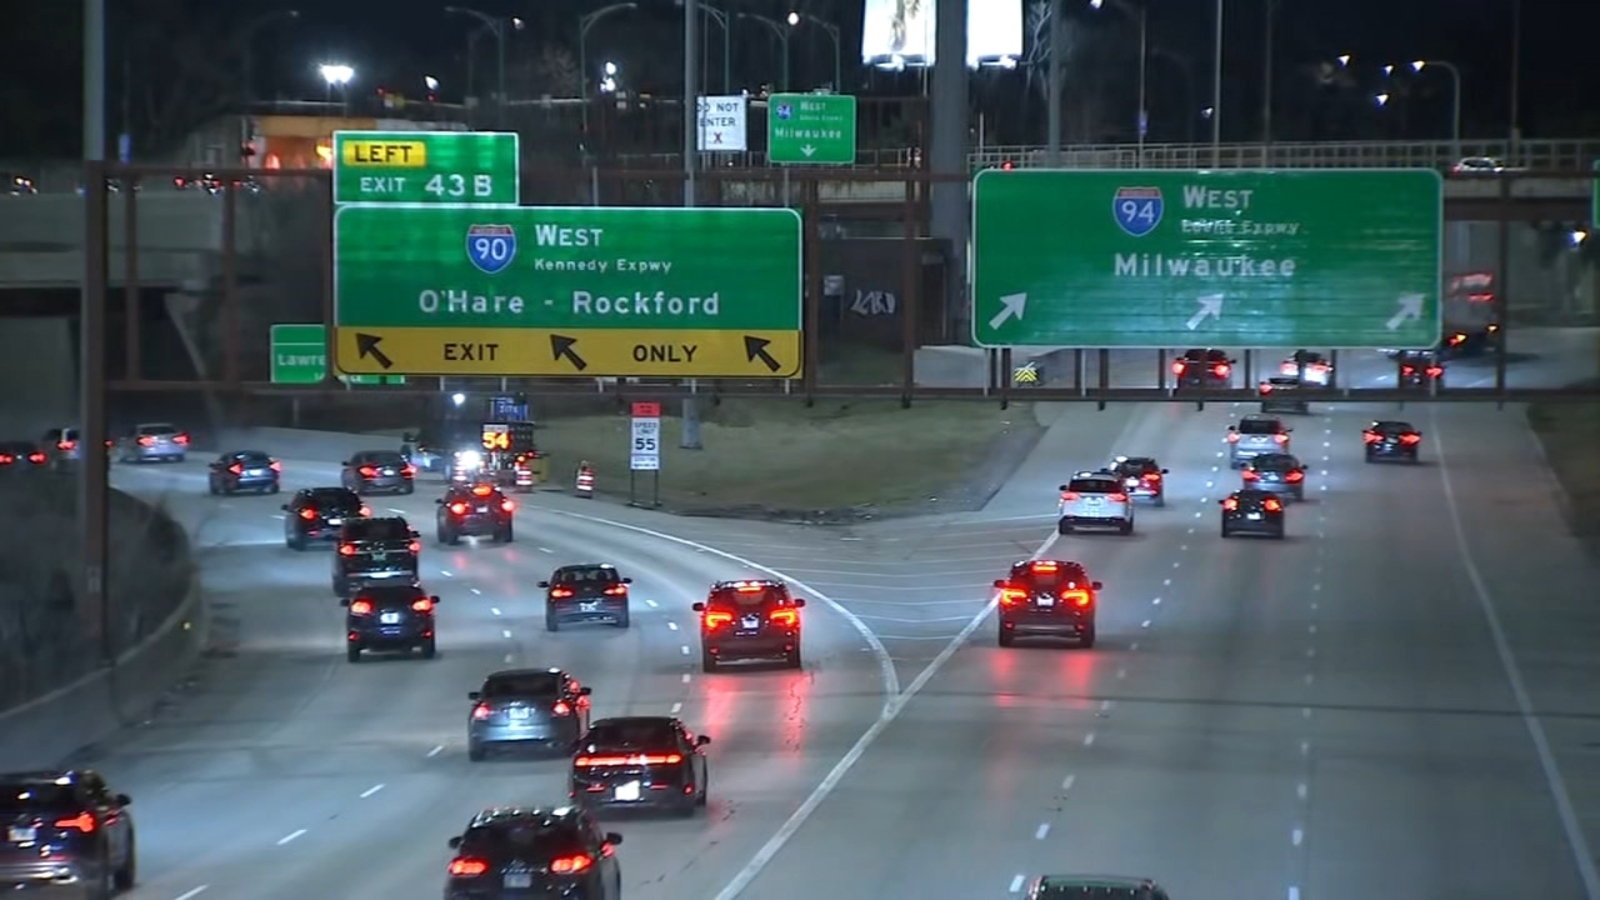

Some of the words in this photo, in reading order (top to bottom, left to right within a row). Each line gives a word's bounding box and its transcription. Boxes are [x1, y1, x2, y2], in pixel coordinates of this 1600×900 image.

[716, 103, 738, 112] NOT
[699, 117, 736, 127] ENTER
[775, 128, 841, 139] Milwaukee
[355, 145, 413, 163] LEFT
[361, 177, 406, 193] EXIT
[1183, 185, 1253, 209] WEST
[1121, 200, 1155, 224] 94
[535, 224, 603, 246] WEST
[475, 238, 507, 260] 90
[535, 258, 608, 273] Kennedy
[616, 258, 672, 274] Expwy
[1114, 253, 1296, 277] Milwaukee
[419, 289, 525, 315] O'Hare
[573, 290, 719, 315] Rockford
[444, 344, 499, 361] EXIT
[633, 344, 697, 362] ONLY
[482, 431, 509, 450] 54
[635, 438, 656, 450] 55
